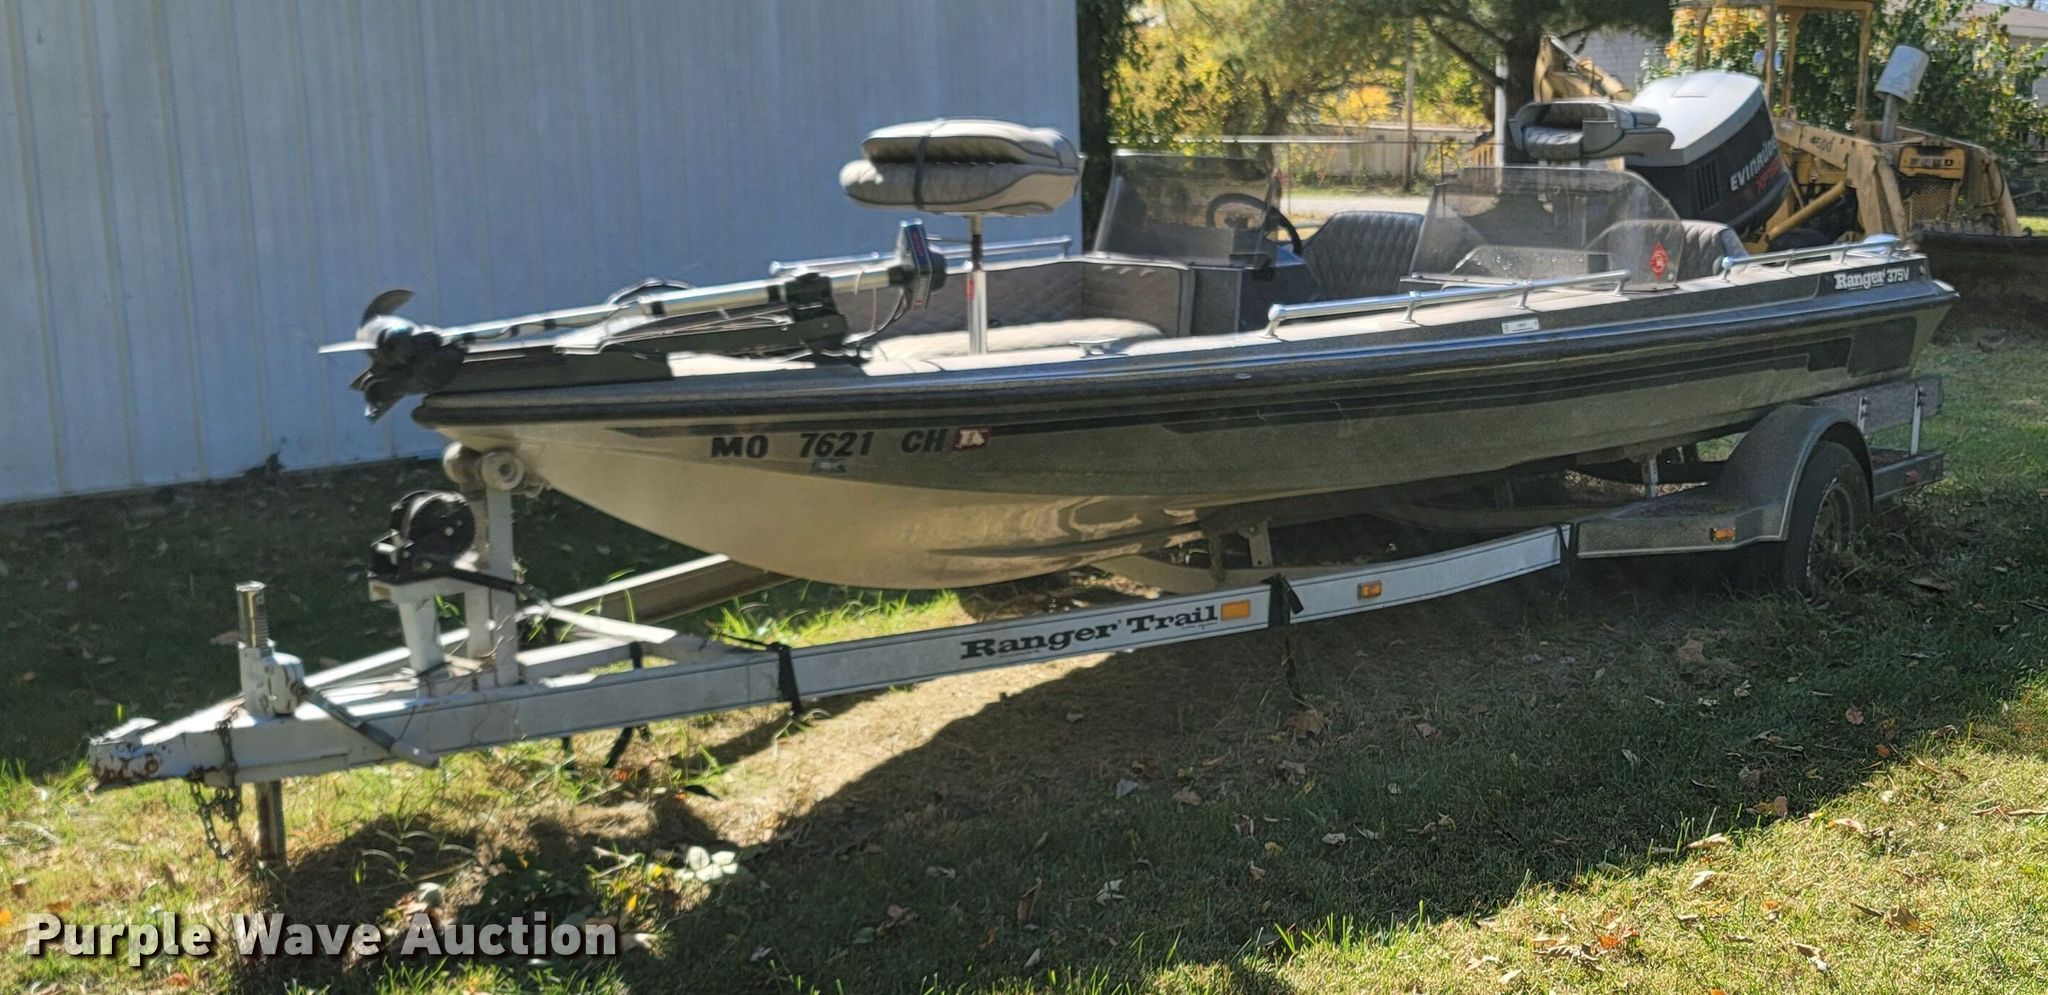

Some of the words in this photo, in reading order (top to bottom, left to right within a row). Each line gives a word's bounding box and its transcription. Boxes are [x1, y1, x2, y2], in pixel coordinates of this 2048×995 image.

[1834, 268, 1886, 290] Ranger
[1886, 266, 1910, 283] 375V
[711, 435, 769, 458] MO
[800, 431, 875, 458] 7621
[901, 428, 949, 453] CH
[960, 623, 1118, 659] Ranger
[1126, 605, 1218, 633] Trail
